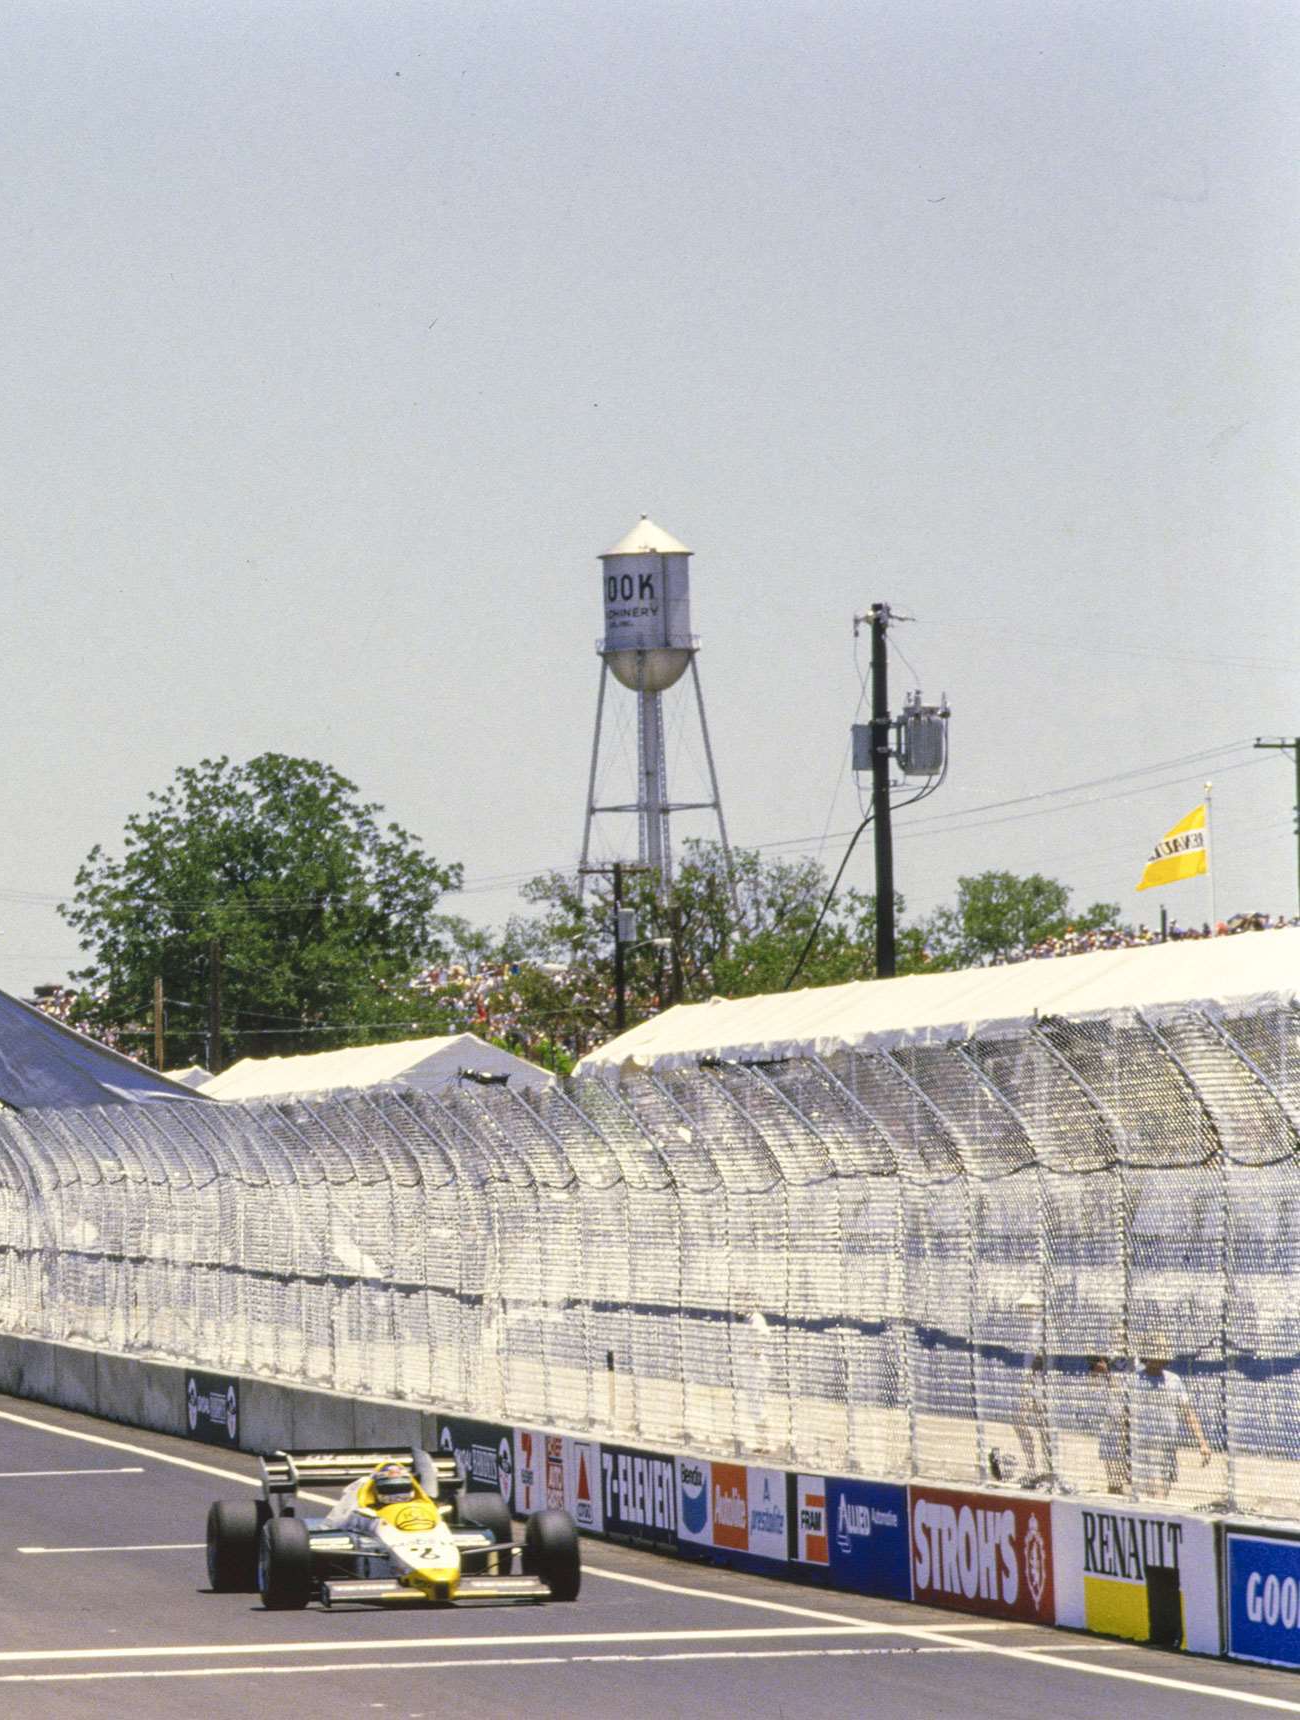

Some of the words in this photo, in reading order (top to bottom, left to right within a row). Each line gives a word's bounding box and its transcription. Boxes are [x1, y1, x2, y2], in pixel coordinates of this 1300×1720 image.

[607, 573, 655, 603] OOK
[602, 1452, 675, 1531] 7-ELEVEN
[800, 1510, 822, 1532] FRAM
[913, 1499, 1018, 1604] STROH'S
[1082, 1511, 1182, 1580] RENAULT
[1246, 1571, 1300, 1629] GOO
